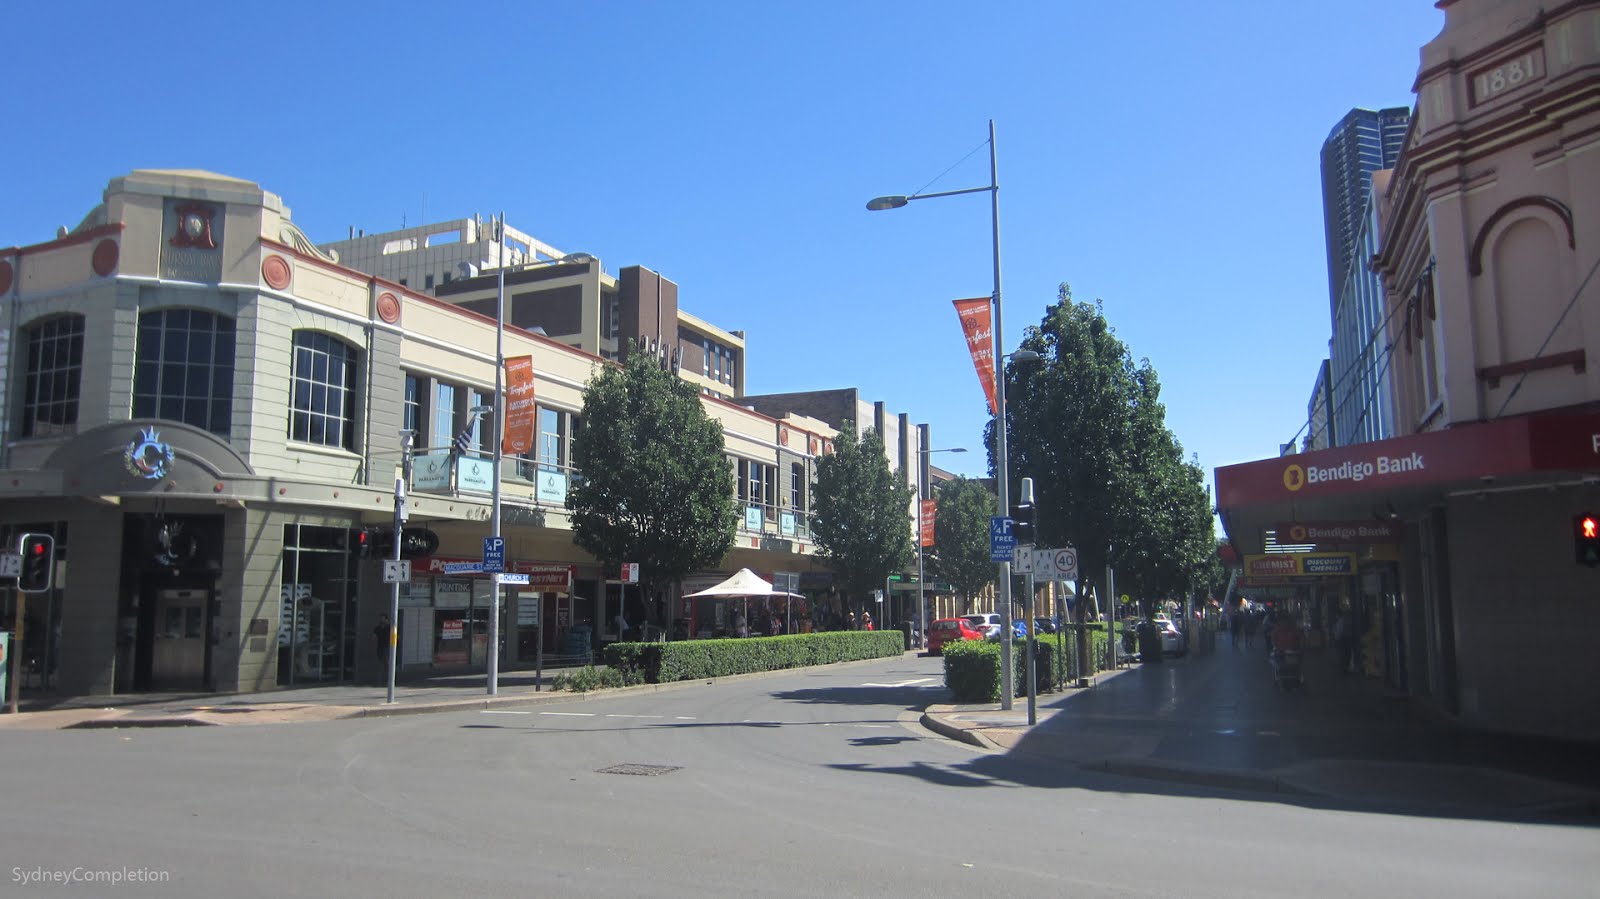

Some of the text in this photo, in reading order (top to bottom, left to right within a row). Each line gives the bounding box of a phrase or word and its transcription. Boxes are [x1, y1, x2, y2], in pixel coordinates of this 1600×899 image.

[1482, 56, 1534, 96] 1881
[1307, 452, 1425, 483] Bendigo Bank
[1308, 526, 1391, 538] Bendigo Bank
[1057, 555, 1073, 566] 40
[1253, 560, 1295, 570] CHEMIST
[1306, 558, 1347, 566] DISCOUNT
[1056, 572, 1077, 580] AREA
[438, 582, 470, 592] PRINTING
